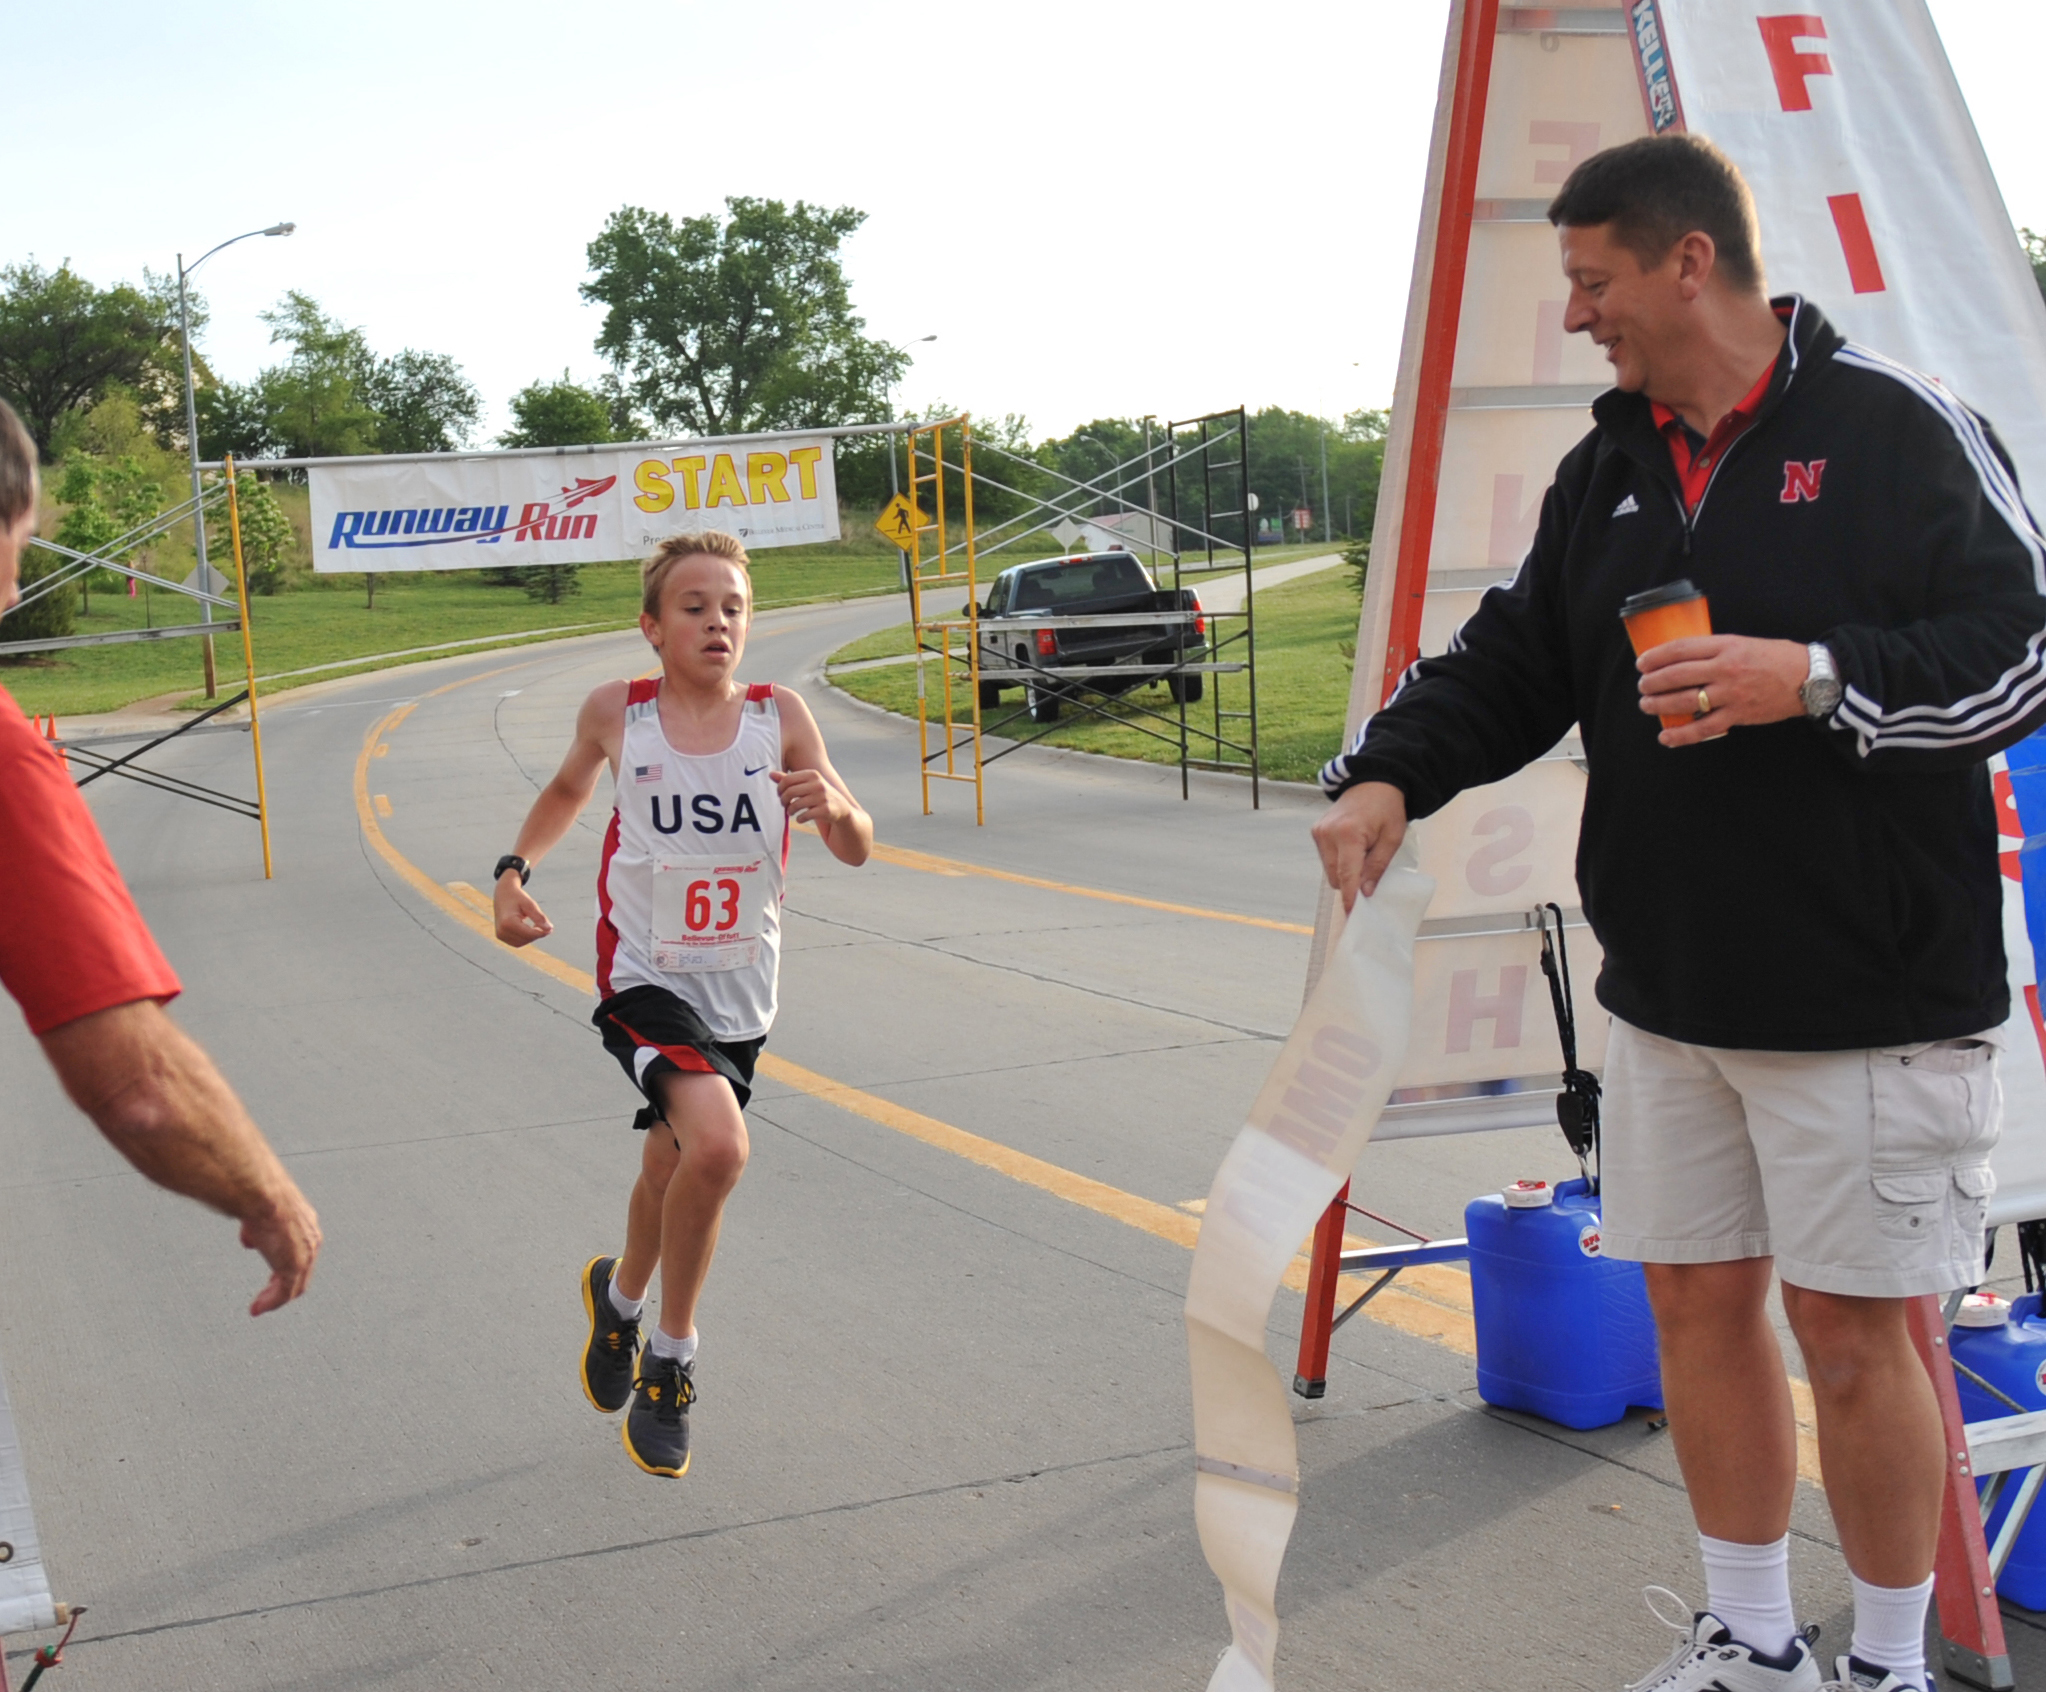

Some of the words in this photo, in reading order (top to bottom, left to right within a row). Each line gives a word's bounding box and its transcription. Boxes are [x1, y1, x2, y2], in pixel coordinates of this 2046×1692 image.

[633, 446, 823, 513] START
[1780, 459, 1826, 503] N
[328, 504, 510, 551] Runway
[514, 500, 599, 542] Run
[651, 793, 761, 834] USA
[685, 878, 740, 932] 63
